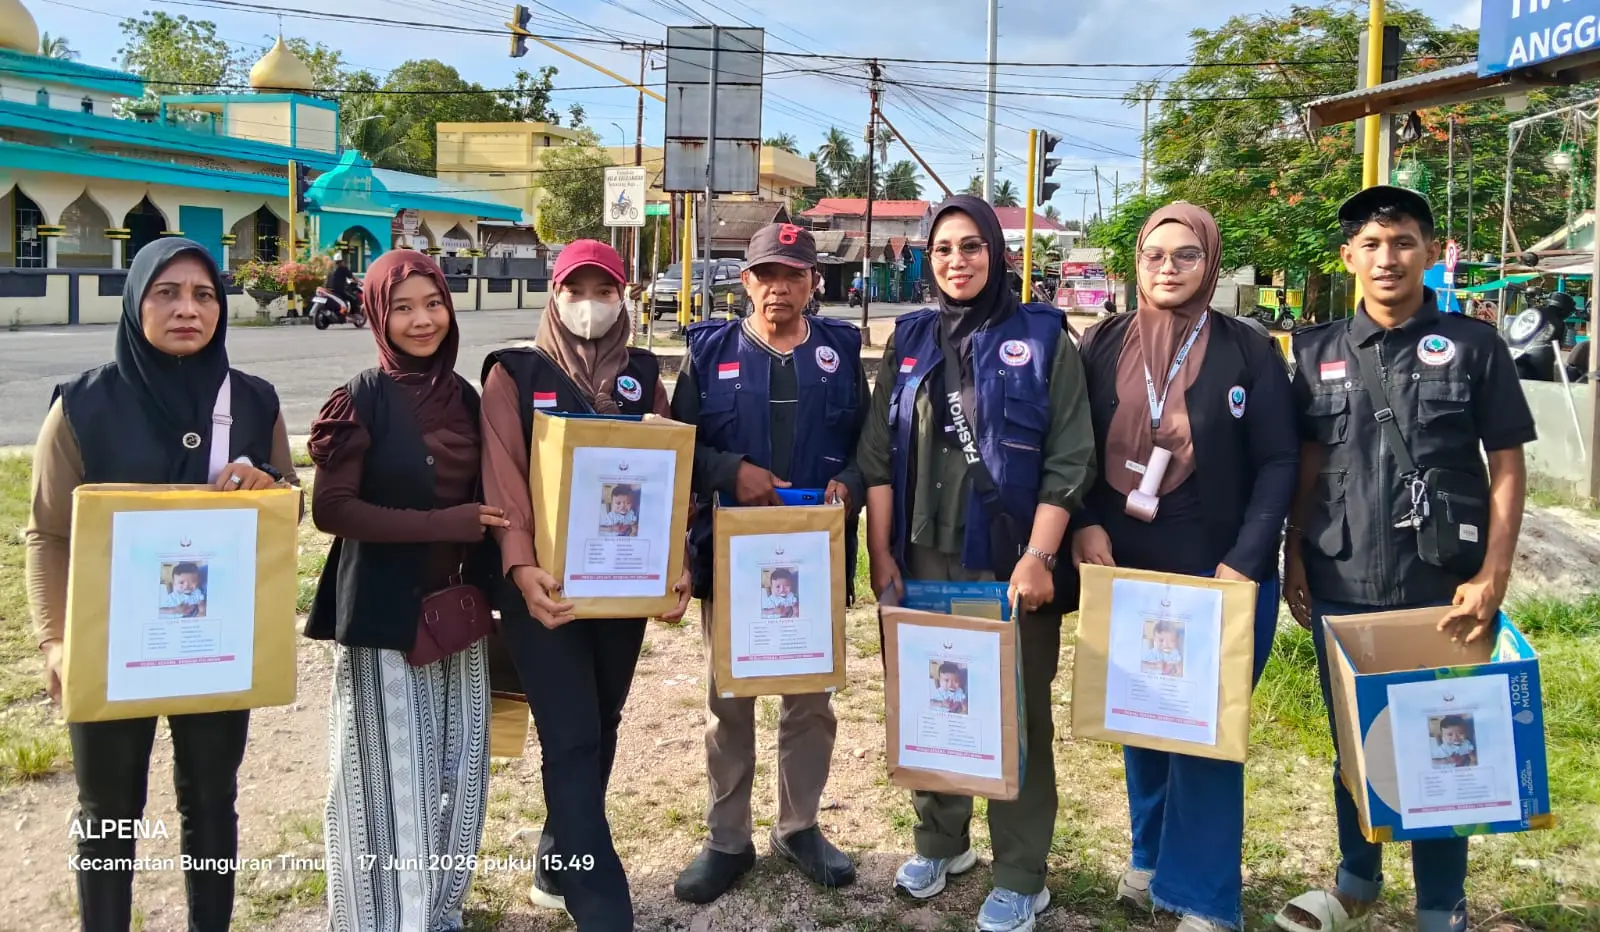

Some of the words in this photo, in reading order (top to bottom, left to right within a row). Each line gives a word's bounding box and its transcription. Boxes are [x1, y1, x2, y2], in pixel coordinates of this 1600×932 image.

[1507, 15, 1600, 67] ANGG
[947, 391, 980, 465] FASHION
[1511, 675, 1521, 706] 100%
[1520, 672, 1531, 708] MURNI
